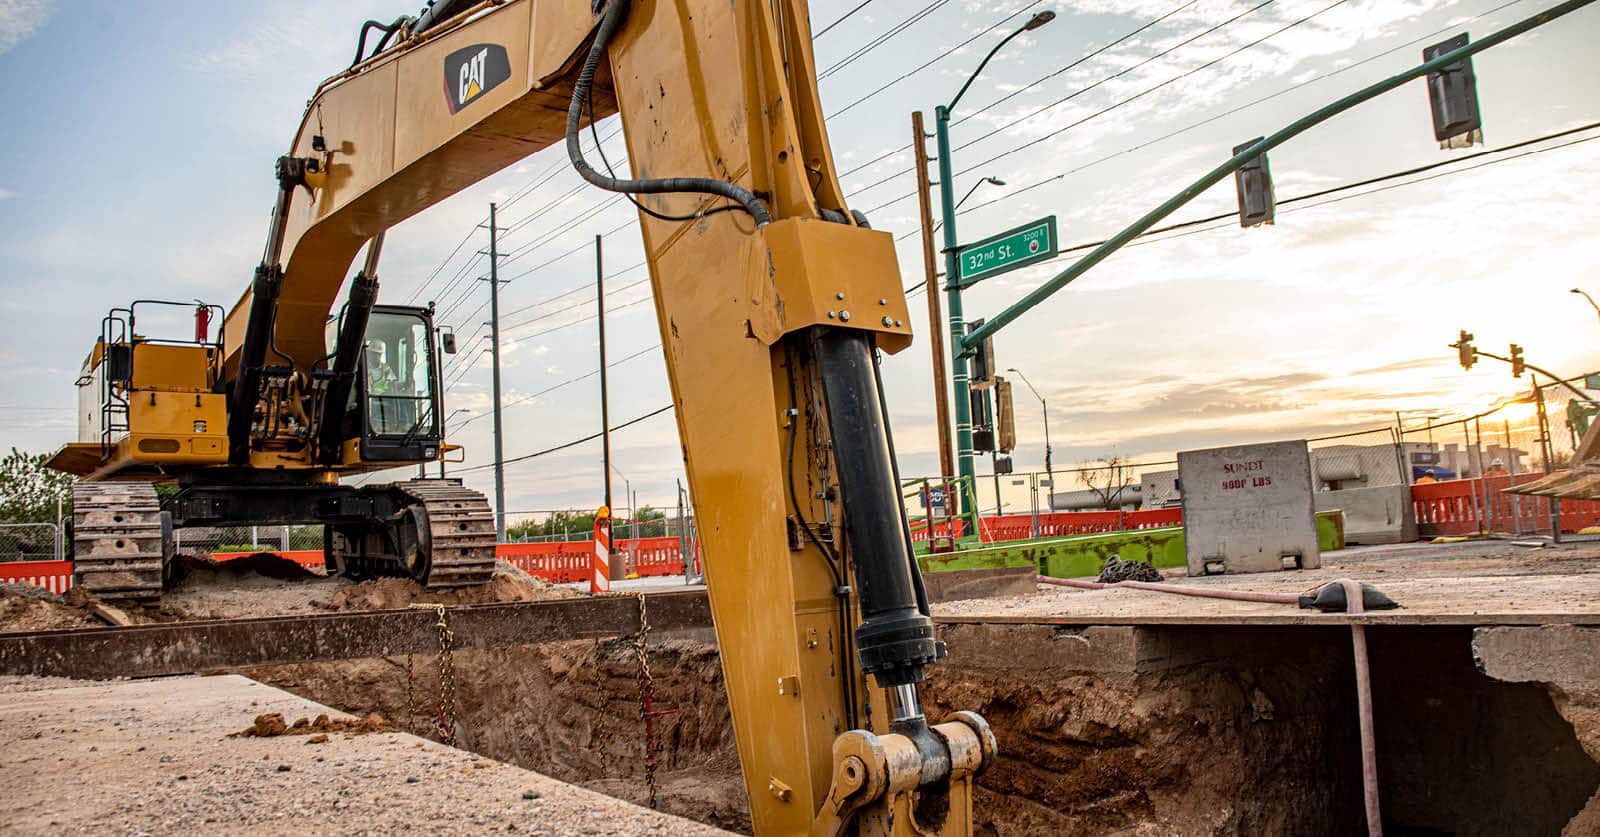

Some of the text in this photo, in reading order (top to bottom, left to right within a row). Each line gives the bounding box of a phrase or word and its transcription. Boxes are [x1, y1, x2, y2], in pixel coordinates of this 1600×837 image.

[459, 47, 488, 104] CAT
[968, 244, 1015, 270] 32nd St.
[1223, 460, 1264, 474] SUNDT
[1252, 476, 1272, 488] LBS
